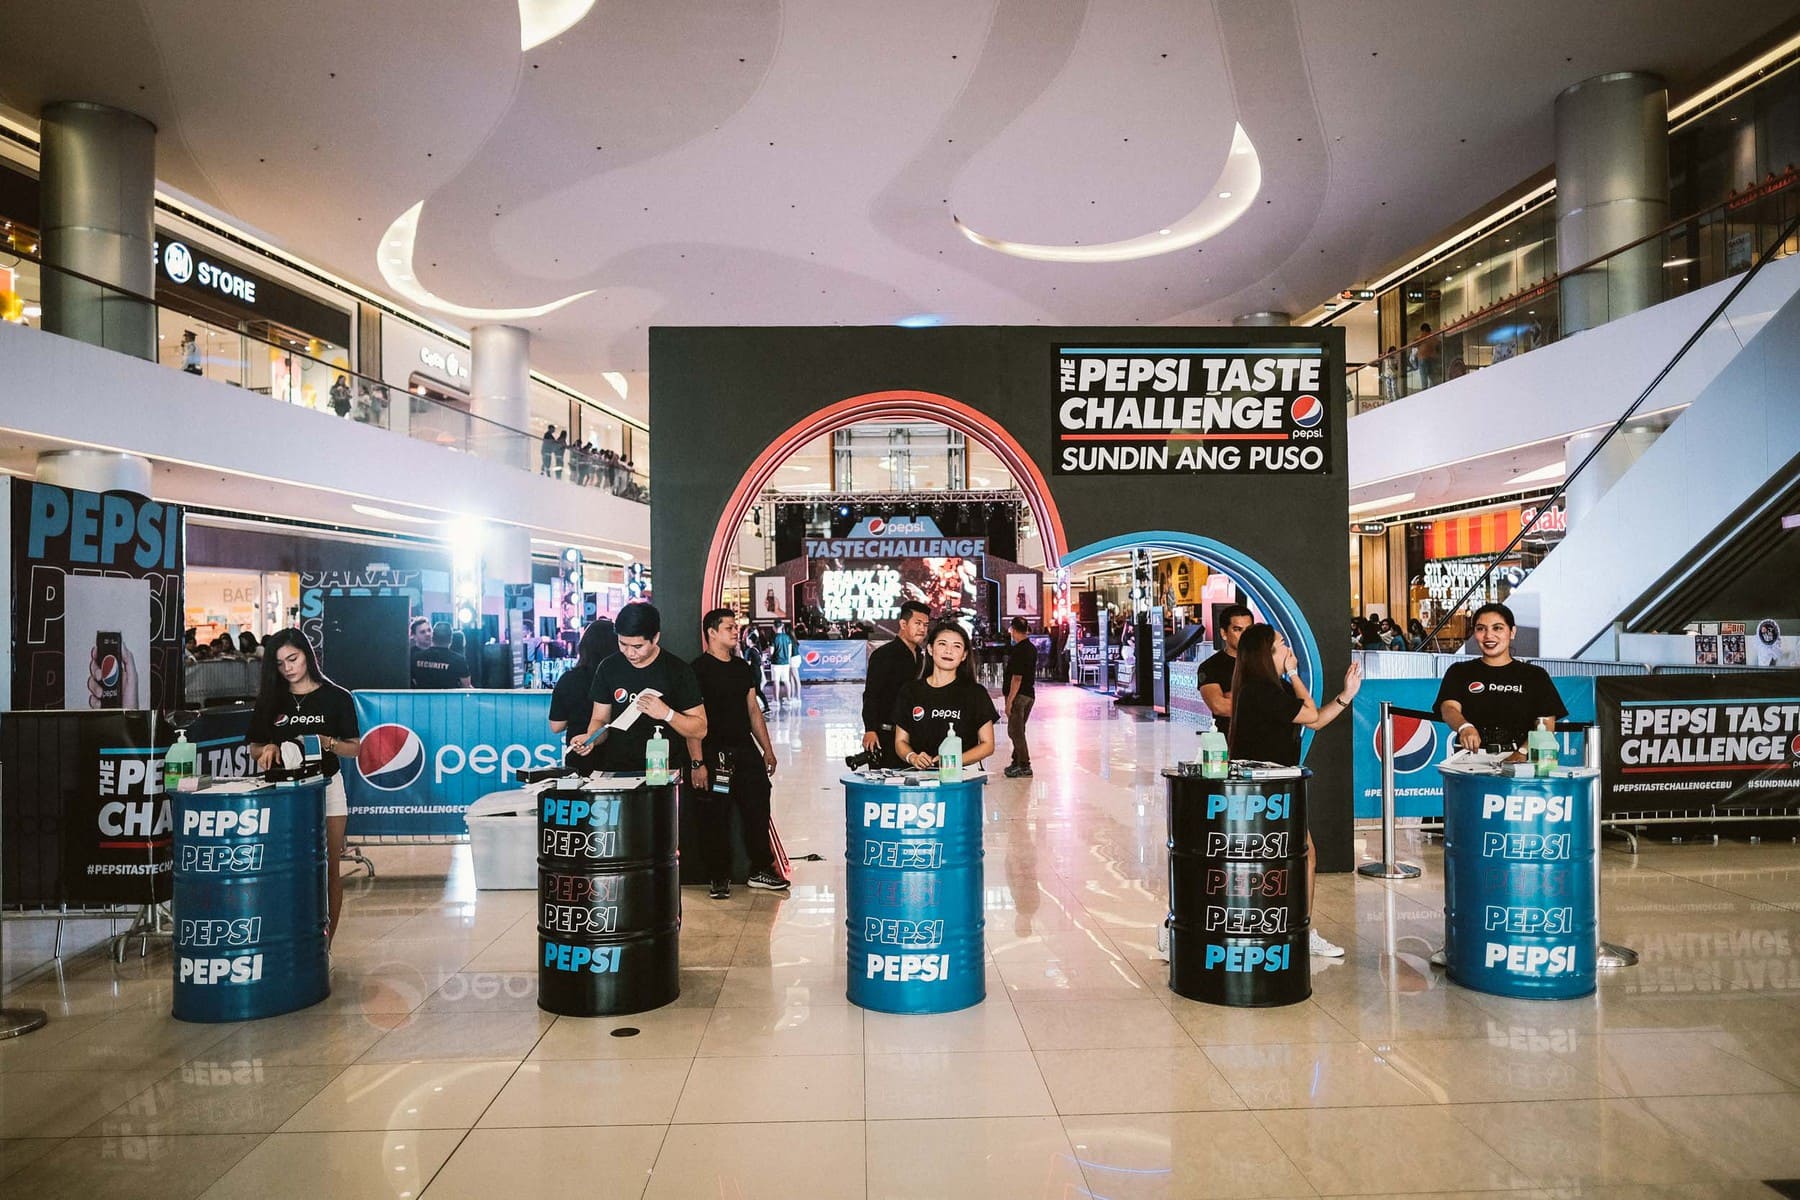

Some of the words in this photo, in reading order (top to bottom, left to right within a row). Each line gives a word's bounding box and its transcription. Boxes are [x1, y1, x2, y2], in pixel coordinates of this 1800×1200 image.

[198, 261, 256, 303] STORE
[1060, 358, 1075, 392] THE
[1078, 358, 1191, 392] PEPSI
[1202, 358, 1321, 392] TASTE
[1059, 397, 1284, 430] CHALLENGE
[1292, 428, 1323, 440] pepsi
[1061, 446, 1168, 471] SUNDIN
[1175, 446, 1241, 471] ANG
[1250, 446, 1323, 471] PUSO
[27, 483, 178, 570] PEPSI
[888, 519, 925, 536] pepsi
[805, 540, 985, 558] TASTECHALLENGE
[27, 565, 179, 644] PSI
[416, 660, 450, 670] SECURITY
[1489, 683, 1523, 694] pepsi
[290, 713, 325, 725] pepsi
[931, 708, 961, 720] pepsi
[1621, 709, 1633, 736] THE
[1635, 707, 1717, 736] PEPSI
[1725, 705, 1800, 732] TAST
[1620, 735, 1788, 765] CHALLENGE
[99, 759, 115, 796] THE
[1613, 780, 1733, 793] #PEPSITASTECHALLENGECEBU
[1748, 779, 1800, 789] #SUNDINAN
[543, 797, 623, 827] PEPSI
[863, 801, 946, 829] PEPSI
[1206, 793, 1291, 821] PEPSI
[1482, 793, 1573, 822] PEPSI
[183, 807, 270, 837] PEPSI
[182, 844, 264, 872] PEPSI
[542, 829, 616, 858] PEPSI
[863, 840, 944, 869] PEPSI
[1206, 832, 1289, 859] PEPSI
[1483, 832, 1571, 860] PEPSI
[544, 875, 622, 902] PEPSI
[1206, 869, 1289, 897] PEPSI
[180, 917, 262, 947] PEPSI
[544, 904, 618, 933] PEPSI
[865, 917, 944, 946] PEPSI
[1205, 905, 1288, 934] PEPSI
[1485, 905, 1573, 934] PEPSI
[180, 954, 264, 985] PEPSI
[545, 942, 623, 974] PEPSI
[866, 954, 949, 982] PEPSI
[1205, 943, 1290, 973] PEPSI
[1485, 942, 1576, 972] PEPSI
